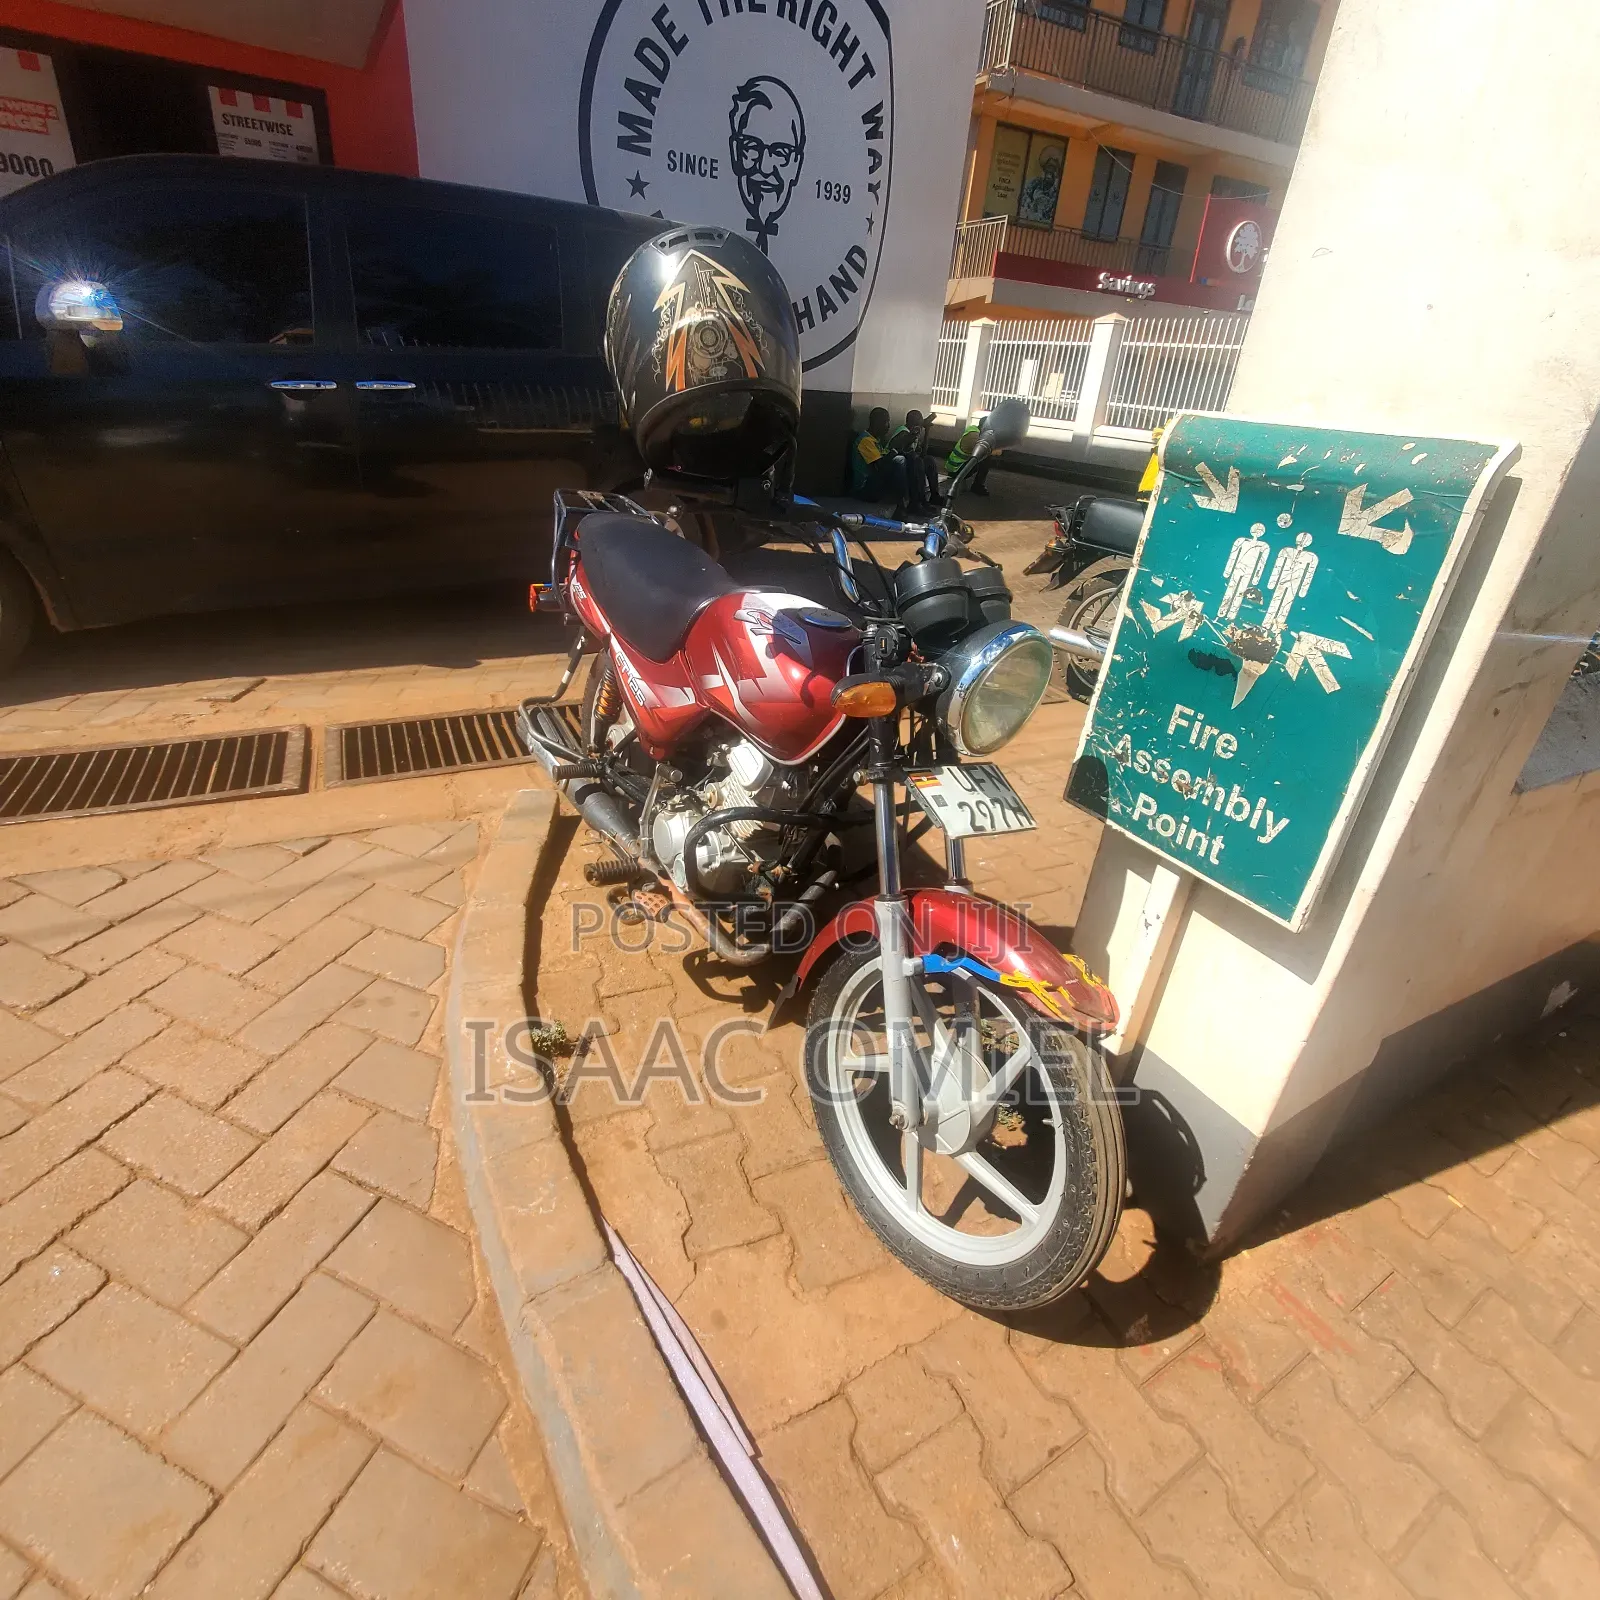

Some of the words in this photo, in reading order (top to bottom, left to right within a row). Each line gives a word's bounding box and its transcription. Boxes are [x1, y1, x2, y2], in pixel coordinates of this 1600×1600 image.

[221, 113, 294, 136] STREETWISE
[617, 4, 690, 157] MADE
[776, 0, 877, 90] RIGHT
[861, 99, 885, 206] WAY
[666, 149, 720, 181] SINCE
[814, 178, 852, 205] 1939
[793, 244, 868, 333] HAND
[1096, 272, 1156, 299] Savings
[1167, 703, 1239, 760] Fire
[946, 764, 1011, 793] UFN
[1108, 733, 1291, 844] Assembly
[956, 796, 1033, 832] 297H
[1131, 792, 1225, 866] Point
